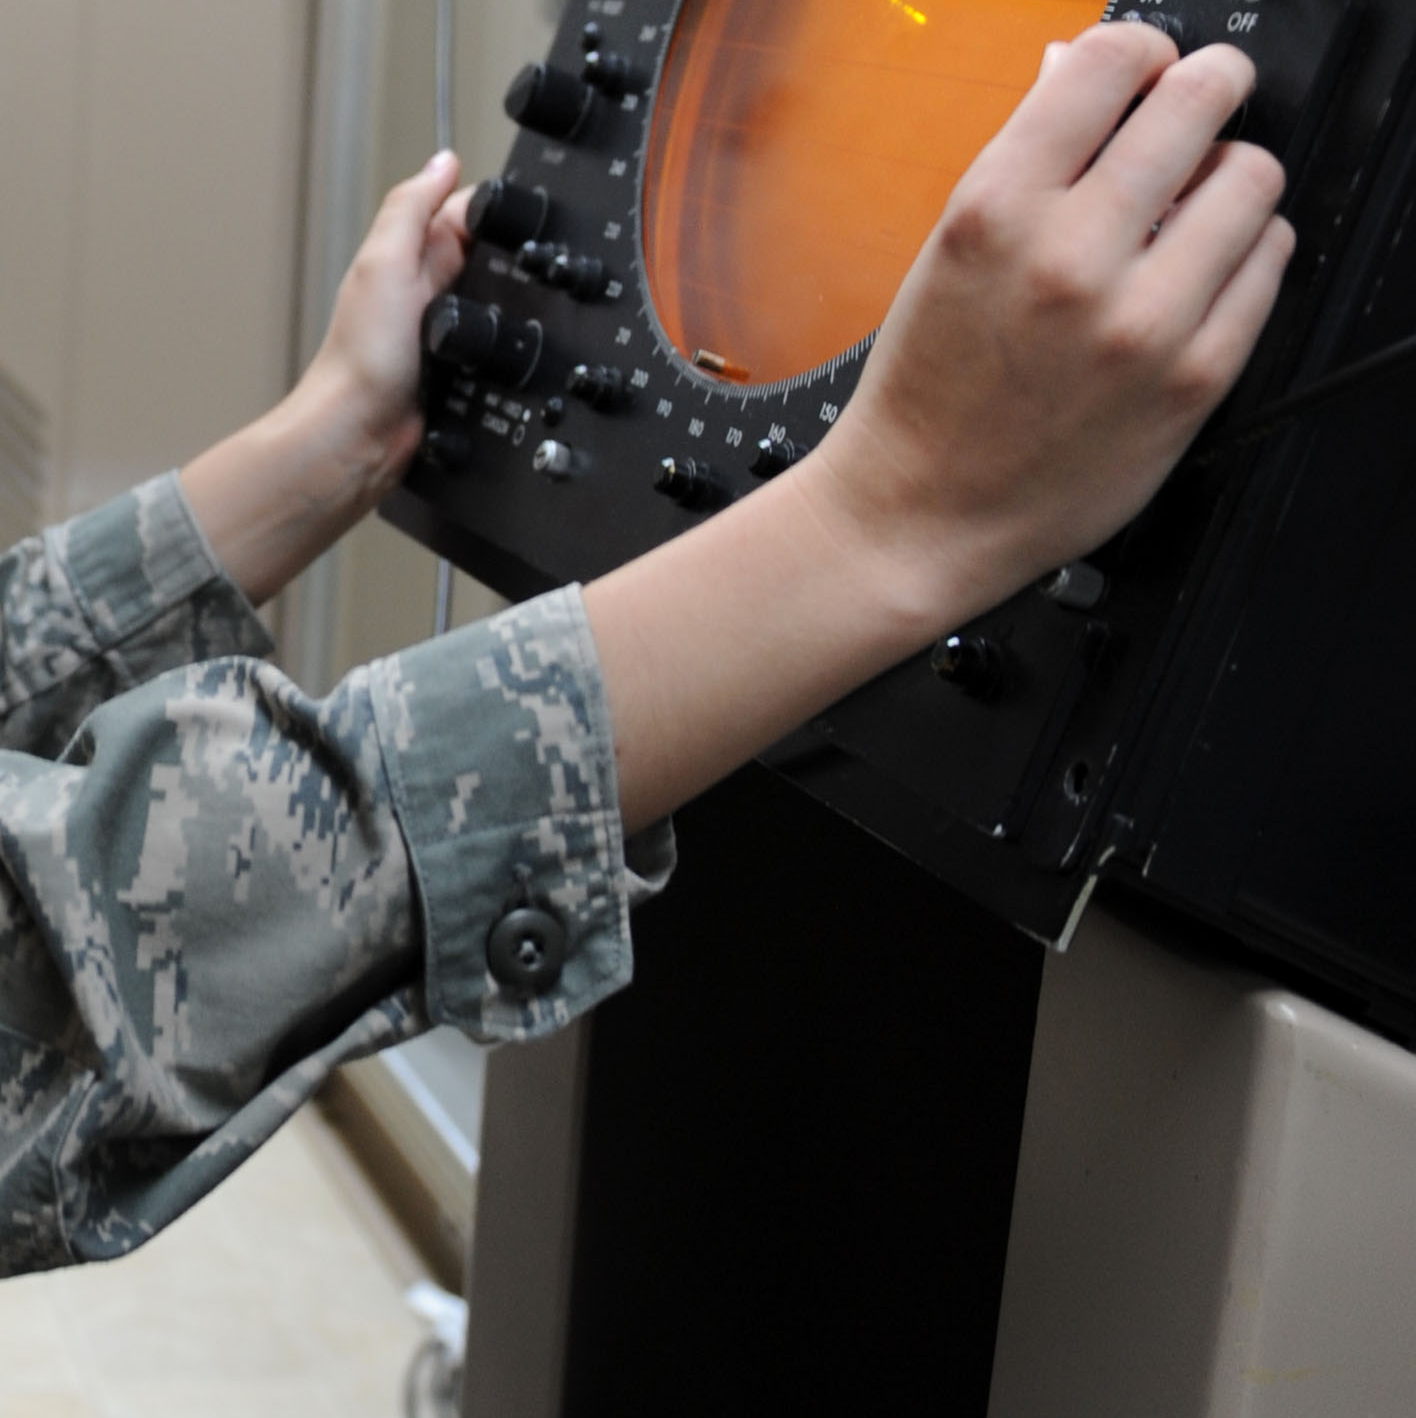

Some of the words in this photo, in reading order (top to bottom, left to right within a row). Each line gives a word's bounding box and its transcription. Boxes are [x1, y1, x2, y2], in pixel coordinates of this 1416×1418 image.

[1226, 12, 1259, 33] OFF
[819, 401, 838, 424] 150
[725, 426, 743, 449] 170
[768, 422, 786, 445] 160
